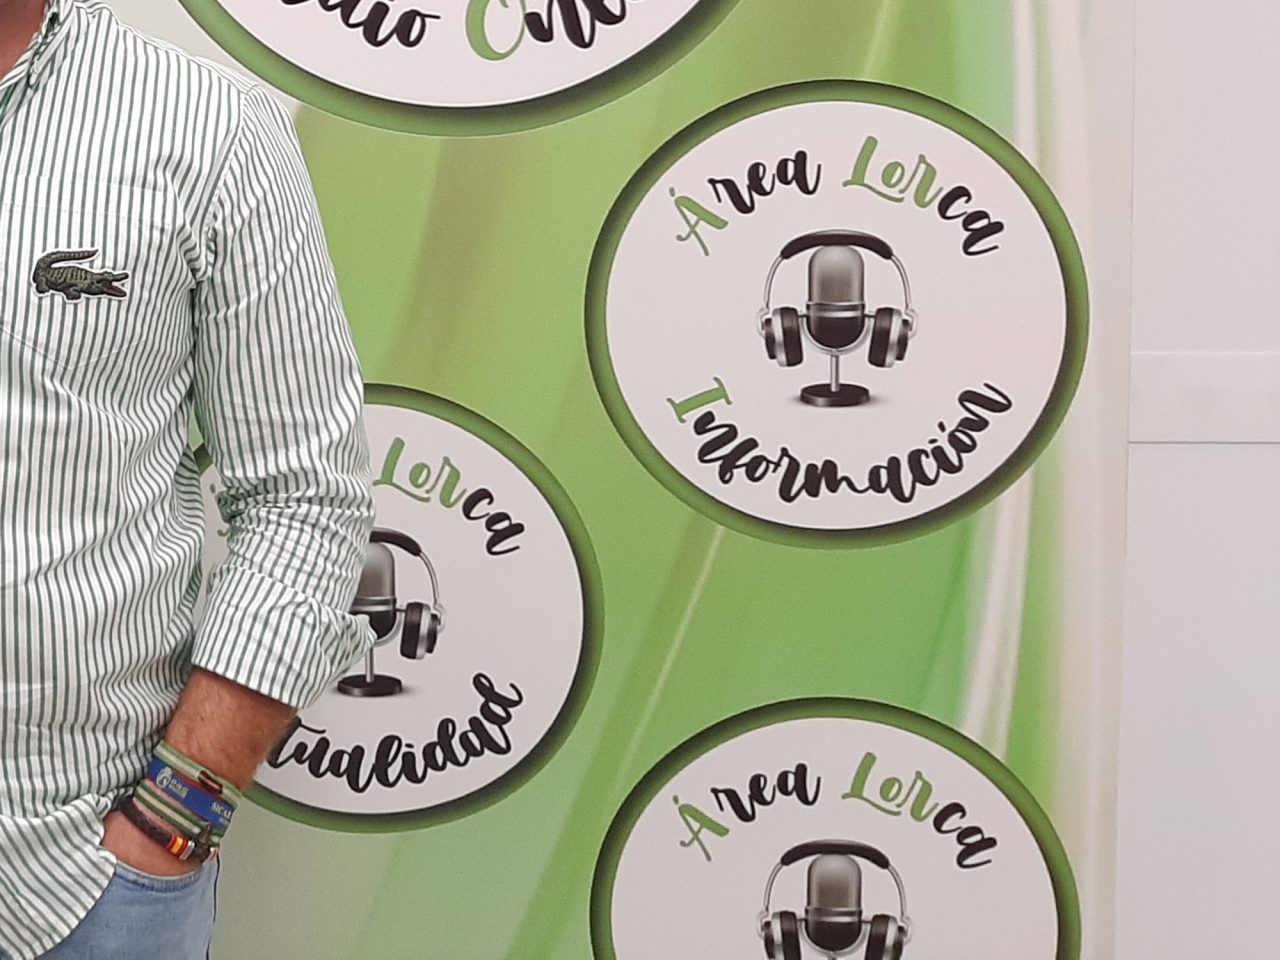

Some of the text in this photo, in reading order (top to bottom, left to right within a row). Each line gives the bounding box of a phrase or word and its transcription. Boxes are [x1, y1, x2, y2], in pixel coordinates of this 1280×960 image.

[669, 136, 1004, 256] Área Lorca
[373, 437, 525, 556] Lorca
[666, 376, 1013, 503] Información
[267, 672, 524, 793] tualidad
[672, 751, 998, 869] Área Lorca
